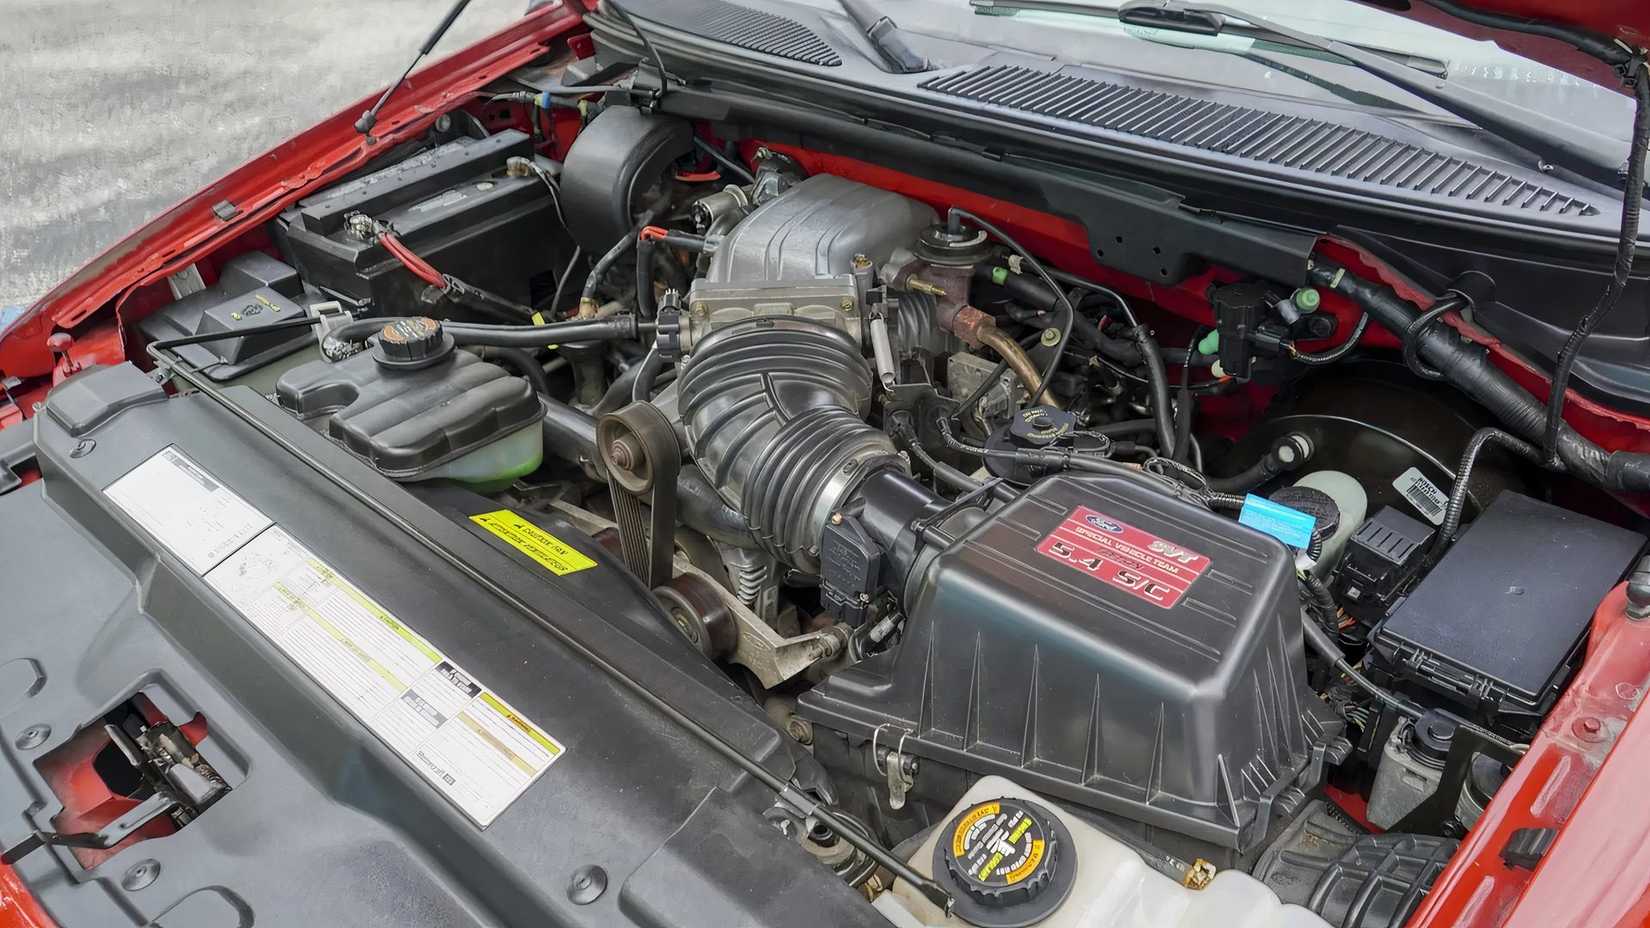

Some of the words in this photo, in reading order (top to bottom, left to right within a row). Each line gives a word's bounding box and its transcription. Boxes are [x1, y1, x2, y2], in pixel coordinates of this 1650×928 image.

[1087, 515, 1122, 533] Ford
[1075, 526, 1113, 545] SPECIAL
[1115, 541, 1154, 562] VEHICLE
[1153, 558, 1179, 574] TEAM
[1148, 540, 1200, 563] SVT
[1049, 542, 1104, 572] 5.4
[1112, 569, 1170, 601] S/C
